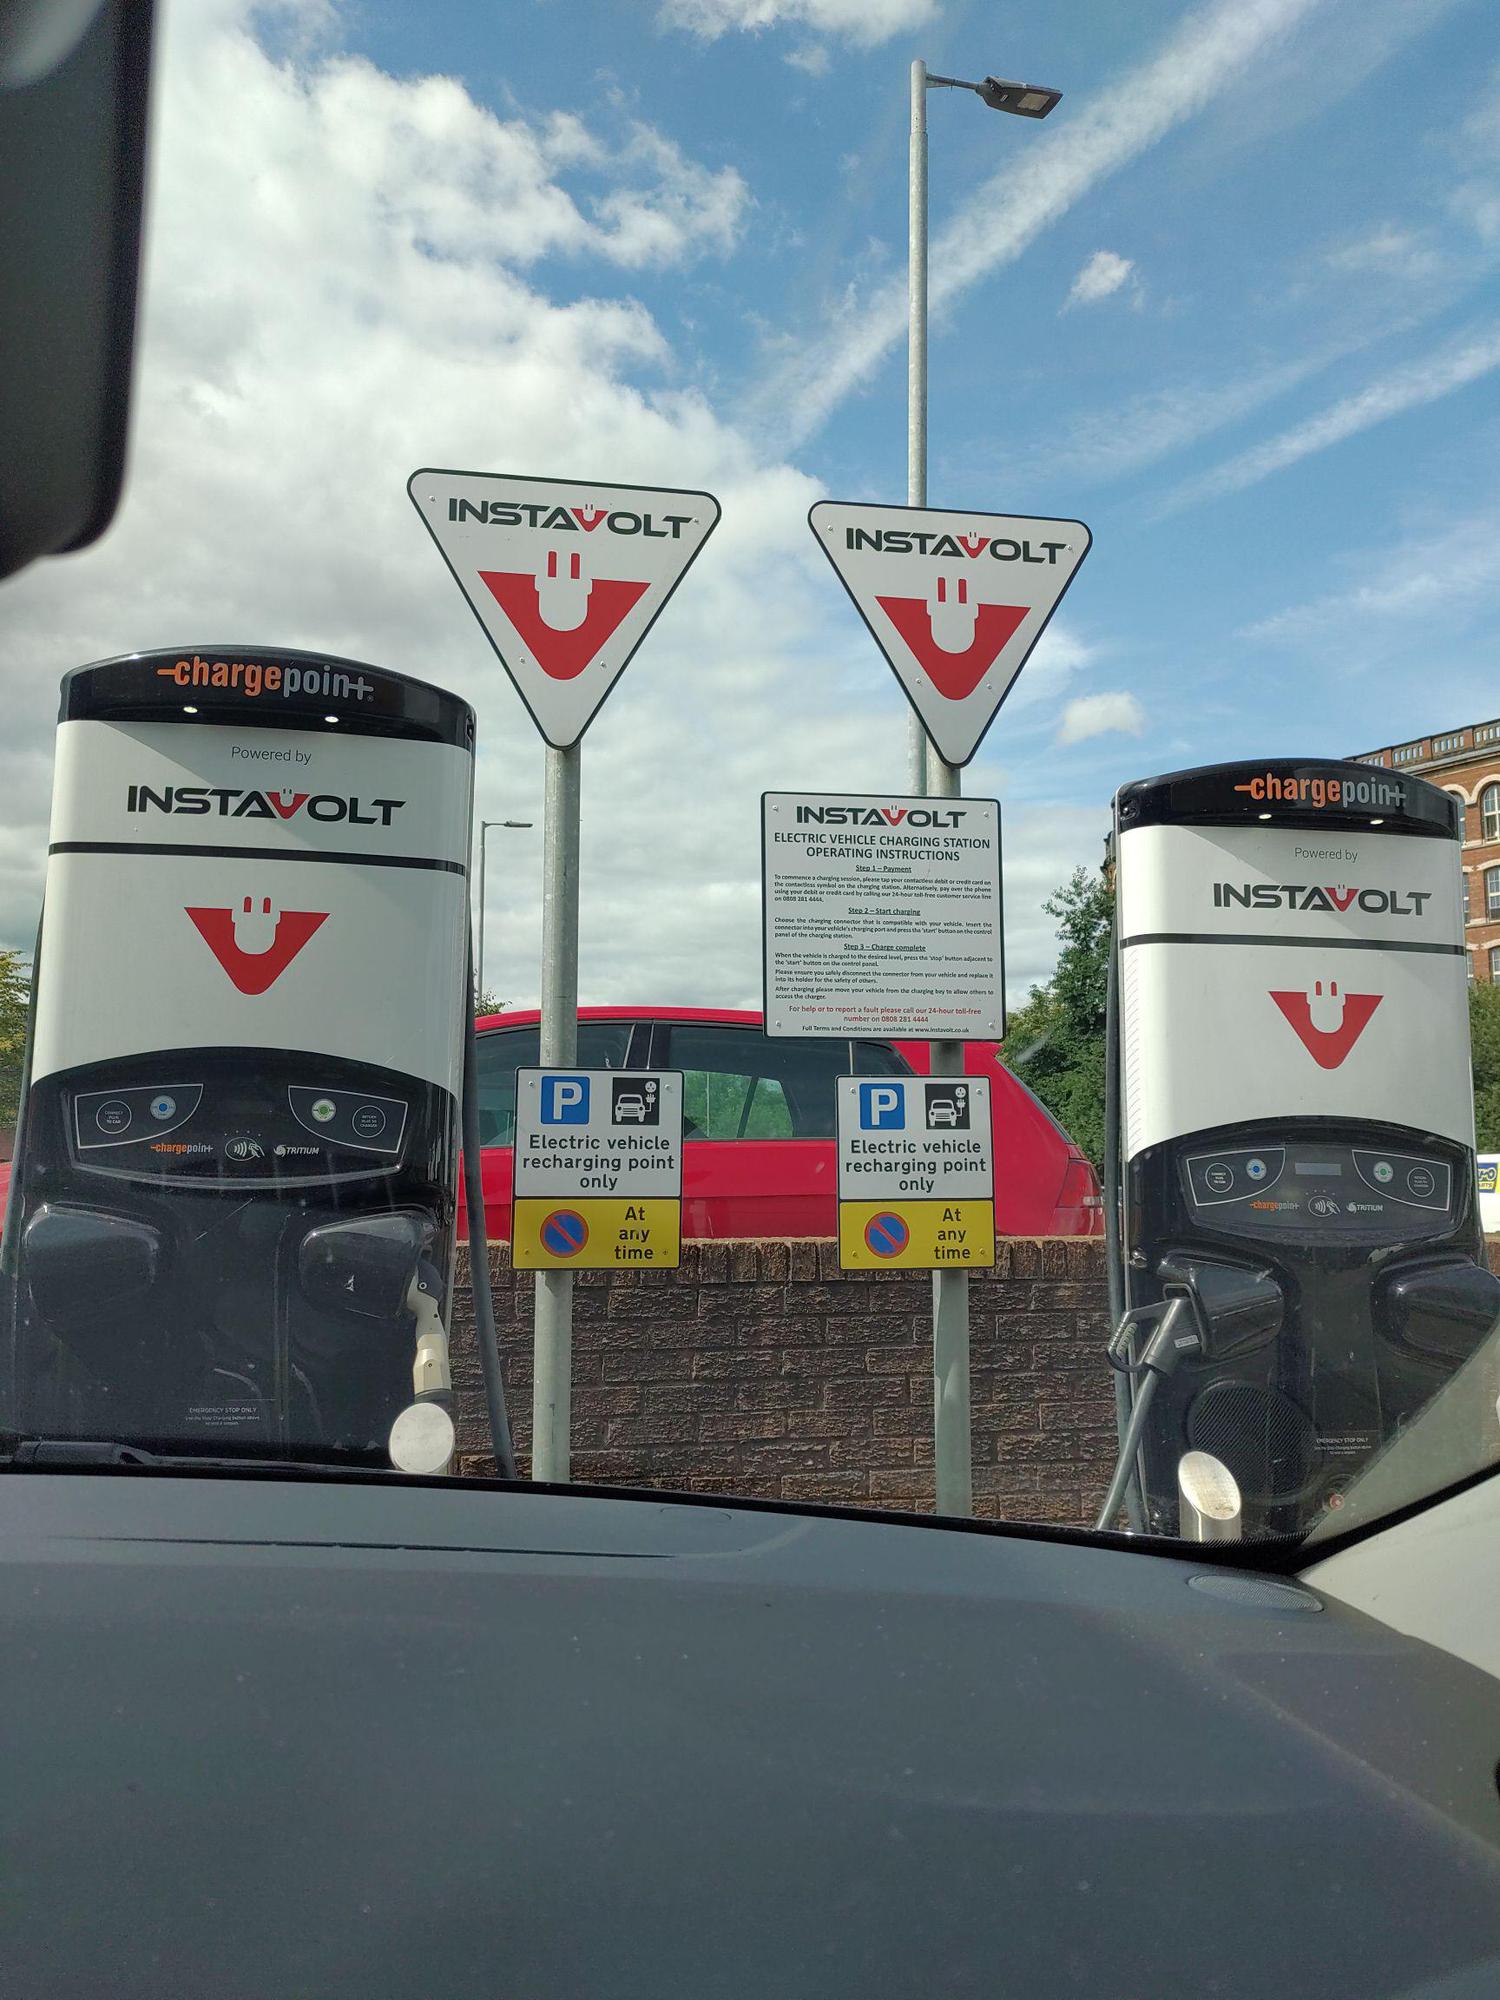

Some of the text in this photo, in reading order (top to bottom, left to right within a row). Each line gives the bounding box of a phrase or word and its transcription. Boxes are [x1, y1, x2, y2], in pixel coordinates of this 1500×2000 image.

[449, 498, 692, 539] INSTAVOLT
[846, 527, 1066, 564] INSTAVOLT
[231, 746, 312, 765] Powered by
[128, 786, 405, 826] INSTAVOLT
[796, 805, 967, 828] INSTAVOLT
[774, 832, 990, 849] ELECTRIC VEHICLE CHARGING STATION
[806, 847, 960, 861] OPERATING INSTRUCTIONS
[1294, 847, 1358, 863] Powered by
[1214, 883, 1432, 916] INSTAVOLT
[835, 1007, 856, 1015] report
[553, 1081, 583, 1120] P
[870, 1088, 898, 1126] P
[530, 1135, 670, 1150] Electric vehicle
[851, 1140, 981, 1154] Electric vehicle
[286, 1147, 319, 1155] TRITIUM
[523, 1155, 674, 1171] recharging point
[846, 1158, 986, 1174] recharging point
[580, 1174, 618, 1191] only
[899, 1177, 934, 1193] only
[625, 1206, 645, 1221] At
[942, 1208, 961, 1222] At
[1356, 1203, 1383, 1212] TRITIUM
[619, 1228, 650, 1243] any
[938, 1229, 966, 1243] any
[615, 1247, 653, 1260] time
[934, 1247, 971, 1259] time
